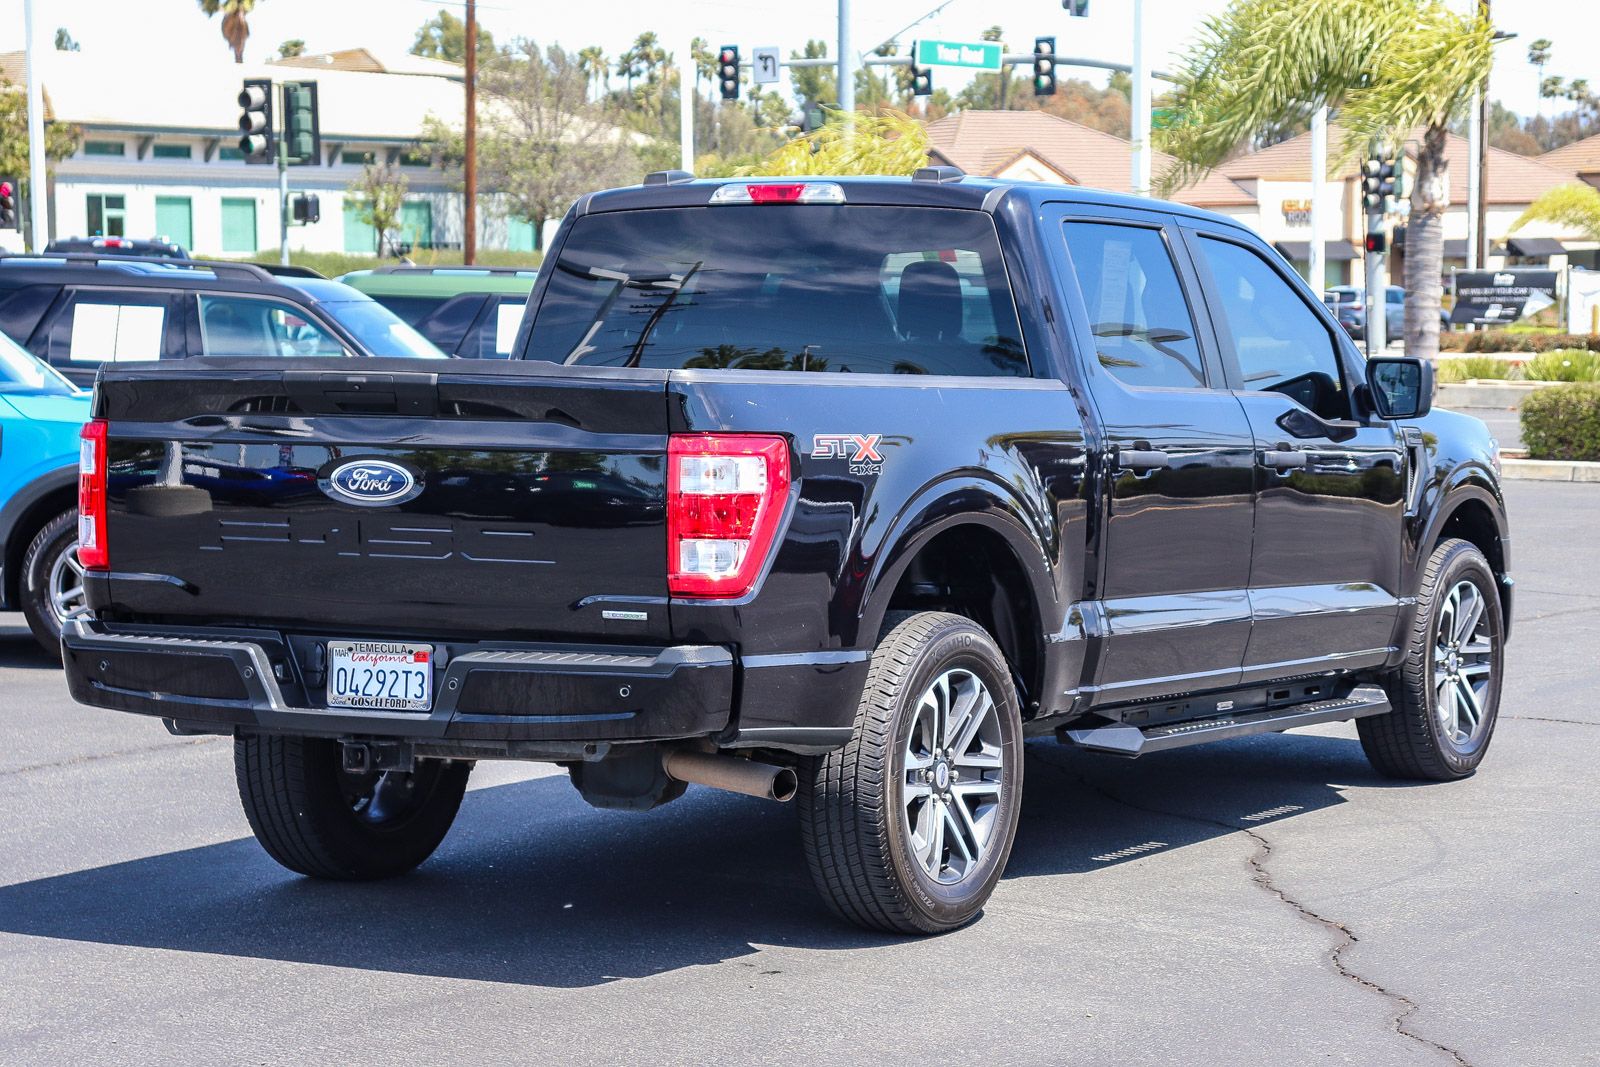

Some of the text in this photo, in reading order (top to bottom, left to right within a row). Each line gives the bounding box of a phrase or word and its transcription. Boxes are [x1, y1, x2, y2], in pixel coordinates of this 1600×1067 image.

[811, 434, 885, 466] STX
[346, 468, 392, 491] Ford
[335, 649, 349, 657] MAR
[353, 643, 407, 654] TEMECULA
[351, 653, 407, 667] California
[336, 667, 425, 699] 04292T3
[385, 698, 407, 709] FORD
